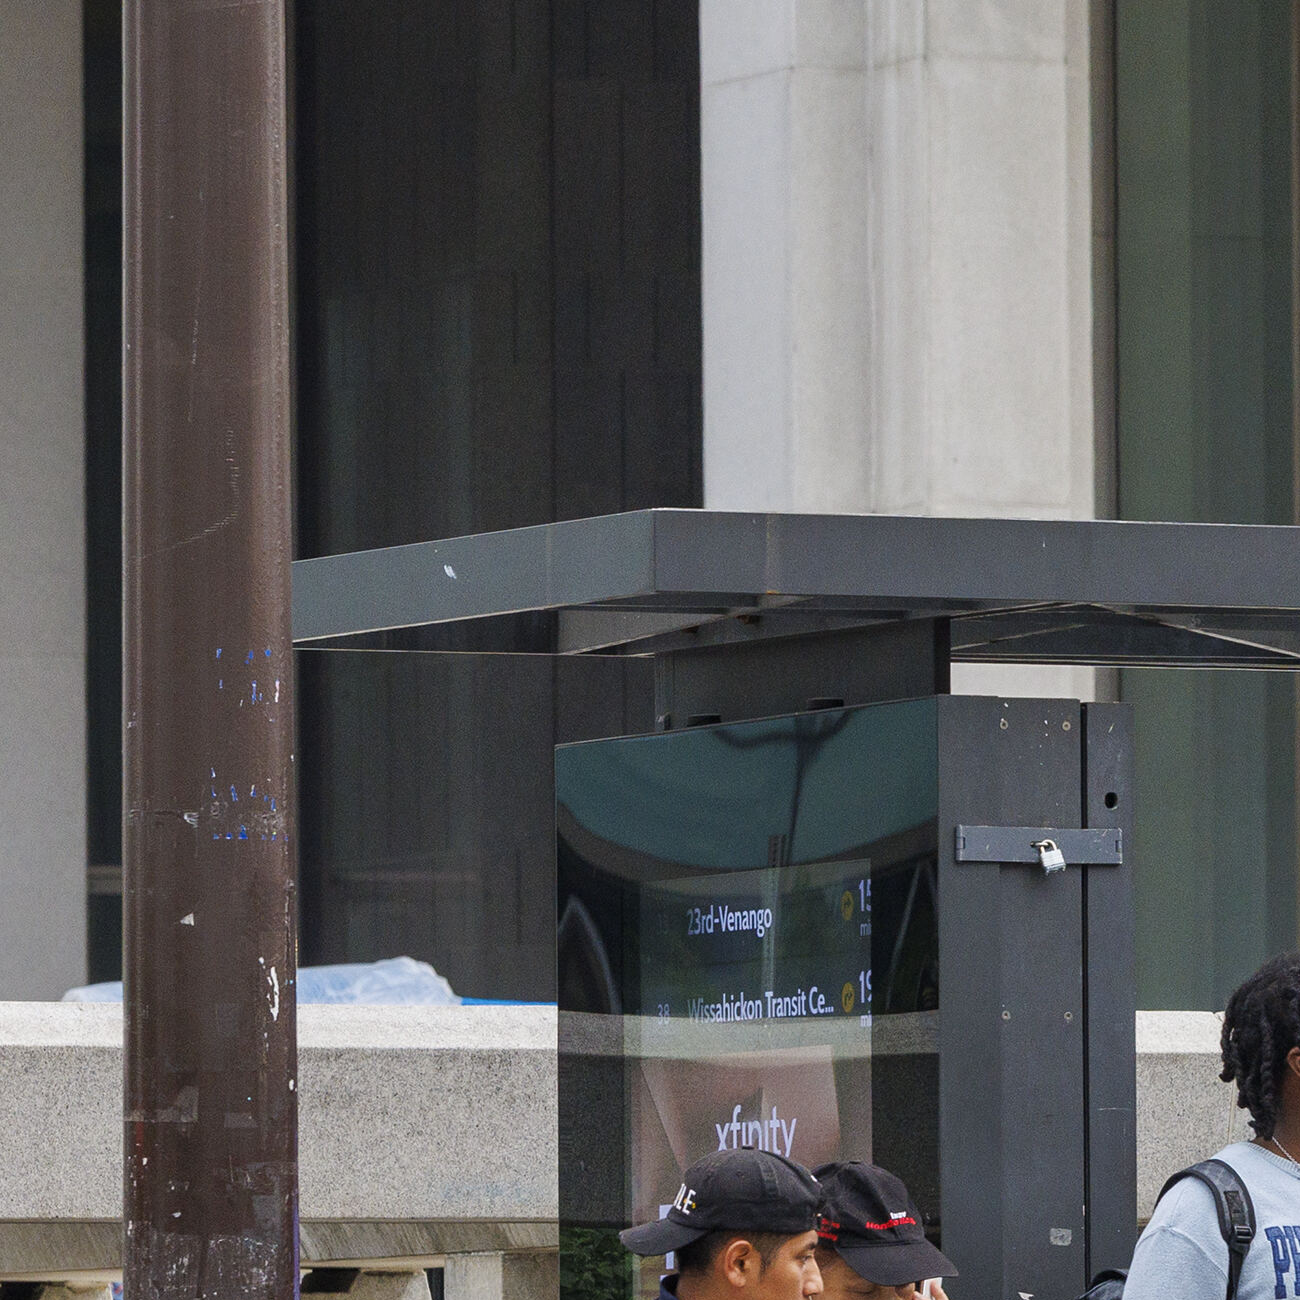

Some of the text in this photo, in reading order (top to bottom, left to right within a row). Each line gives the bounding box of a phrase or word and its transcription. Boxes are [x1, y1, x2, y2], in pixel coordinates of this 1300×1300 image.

[687, 905, 773, 938] 23rd-Venango
[687, 992, 763, 1024] Wissahickon
[765, 988, 807, 1017] Transit
[715, 1104, 797, 1157] xfinity
